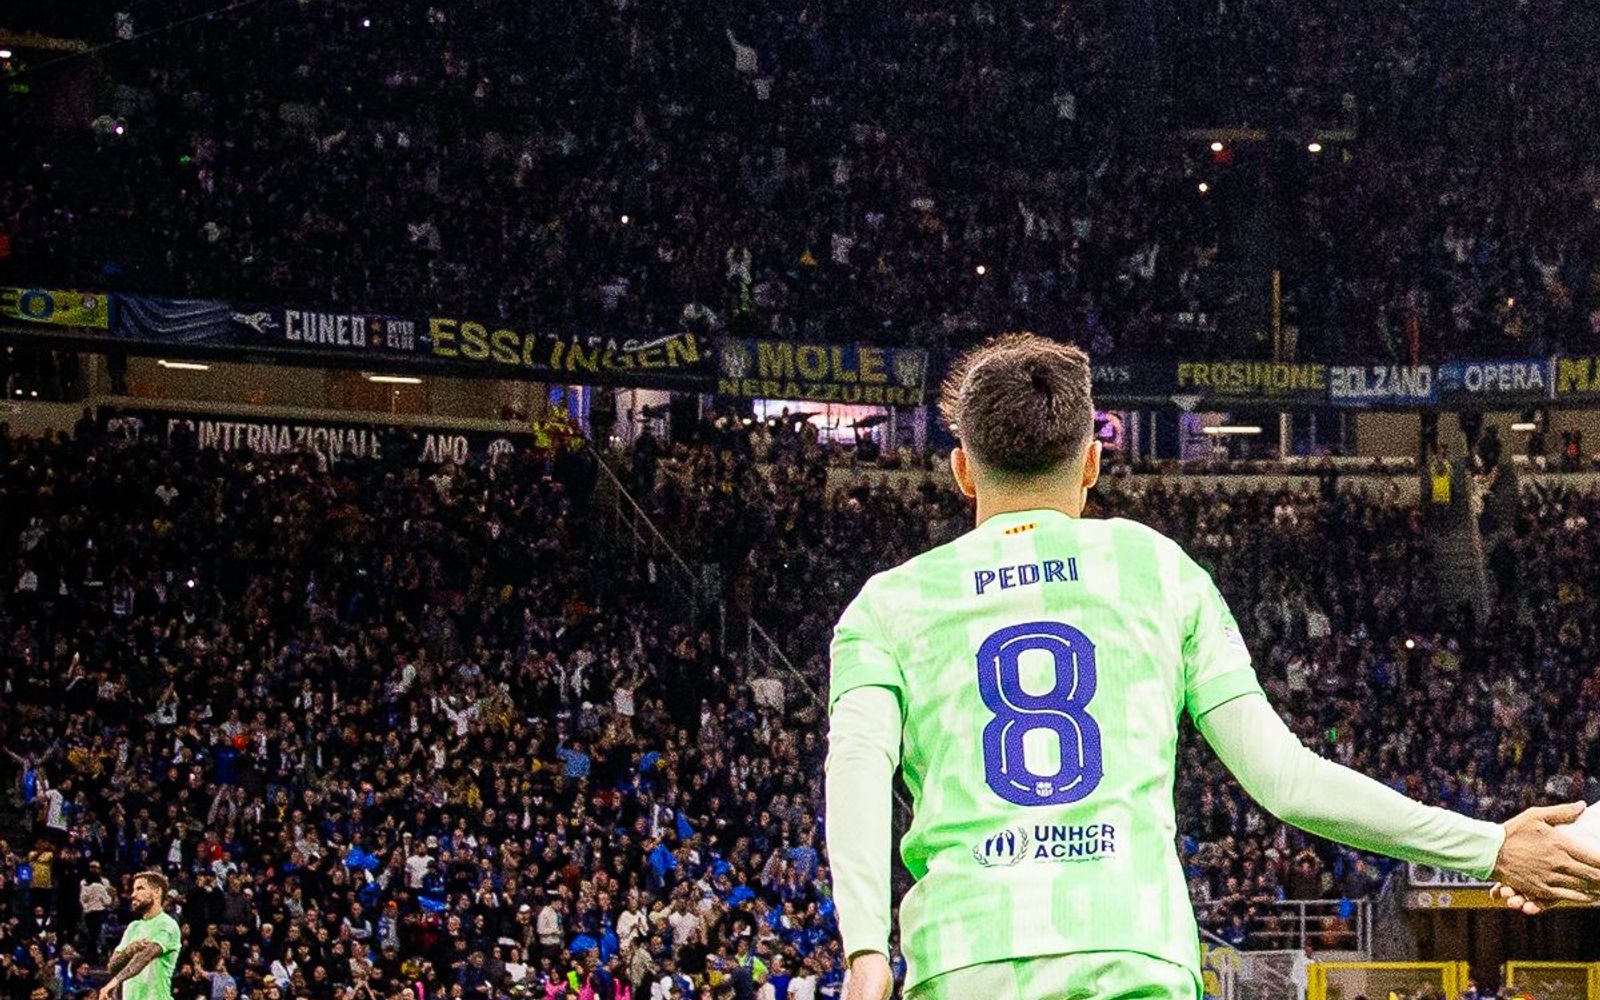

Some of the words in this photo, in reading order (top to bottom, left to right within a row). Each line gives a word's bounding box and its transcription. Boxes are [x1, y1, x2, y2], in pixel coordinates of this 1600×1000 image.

[285, 309, 366, 347] CUNEO
[757, 340, 888, 383] MOLE
[1177, 362, 1326, 390] FROSINONE
[1464, 362, 1544, 391] OPERA
[974, 557, 1079, 594] PEDRI
[976, 621, 1103, 807] 8
[1034, 824, 1115, 842] UNHCR
[1034, 839, 1115, 859] ACNUR
